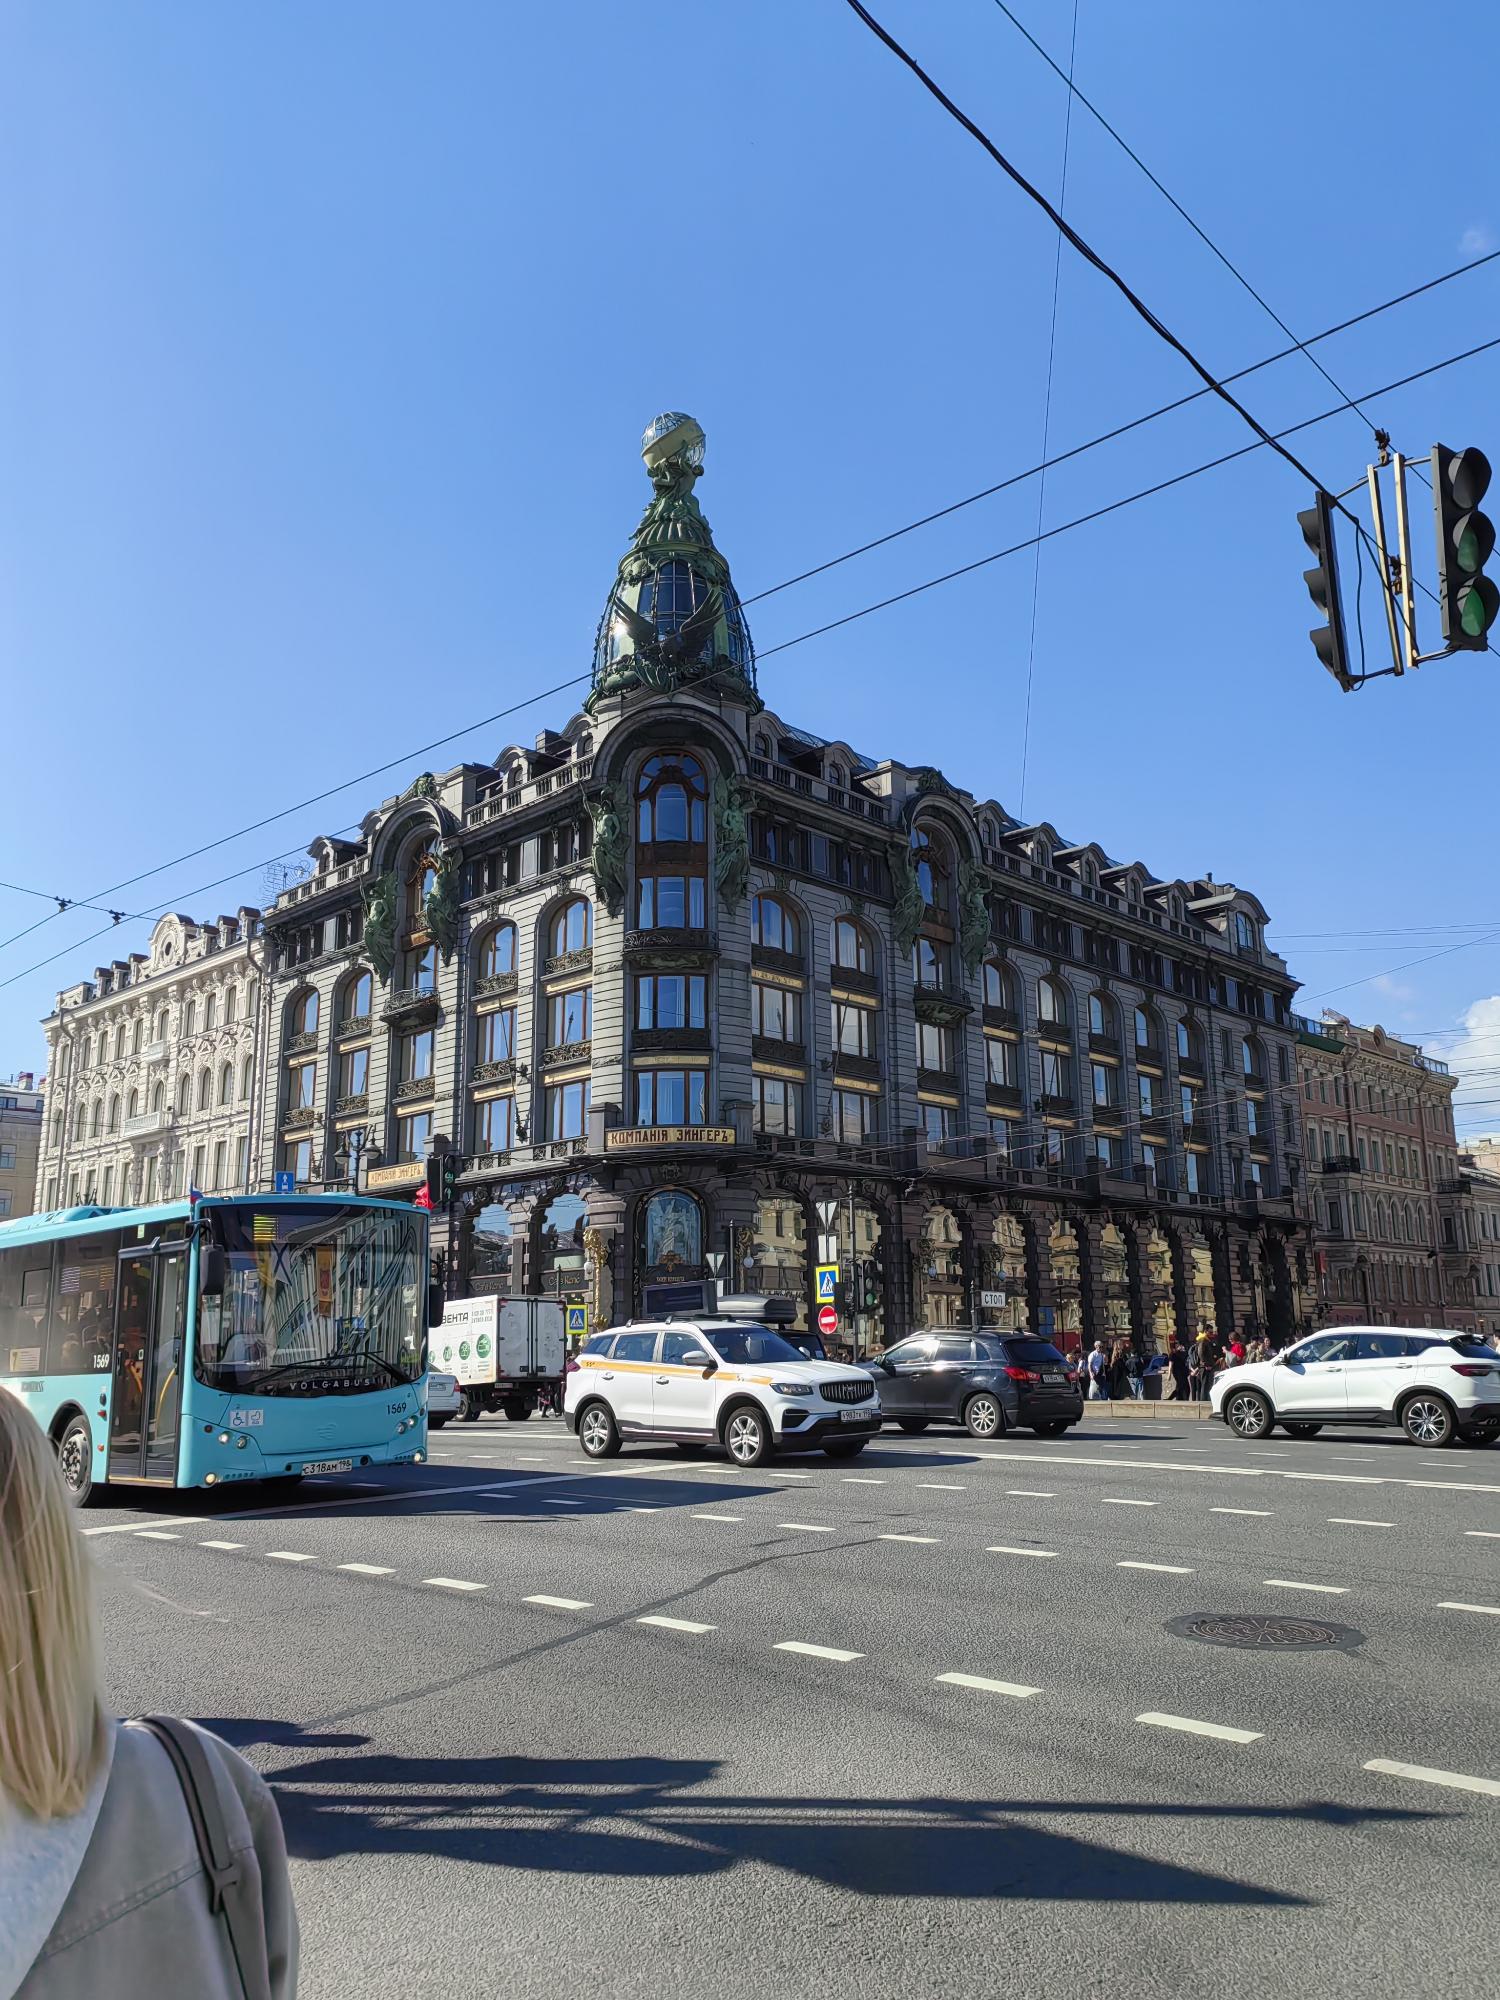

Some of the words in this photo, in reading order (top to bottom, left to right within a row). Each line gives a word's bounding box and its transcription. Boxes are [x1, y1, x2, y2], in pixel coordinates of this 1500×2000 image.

[611, 1129, 668, 1145] КОМПАНІЯ
[676, 1128, 728, 1142] ЗИНГЕРЪ
[984, 1294, 1003, 1305] СТОП
[93, 1354, 110, 1369] 1569
[290, 1379, 370, 1390] VOLGABUS
[386, 1402, 407, 1415] 1569
